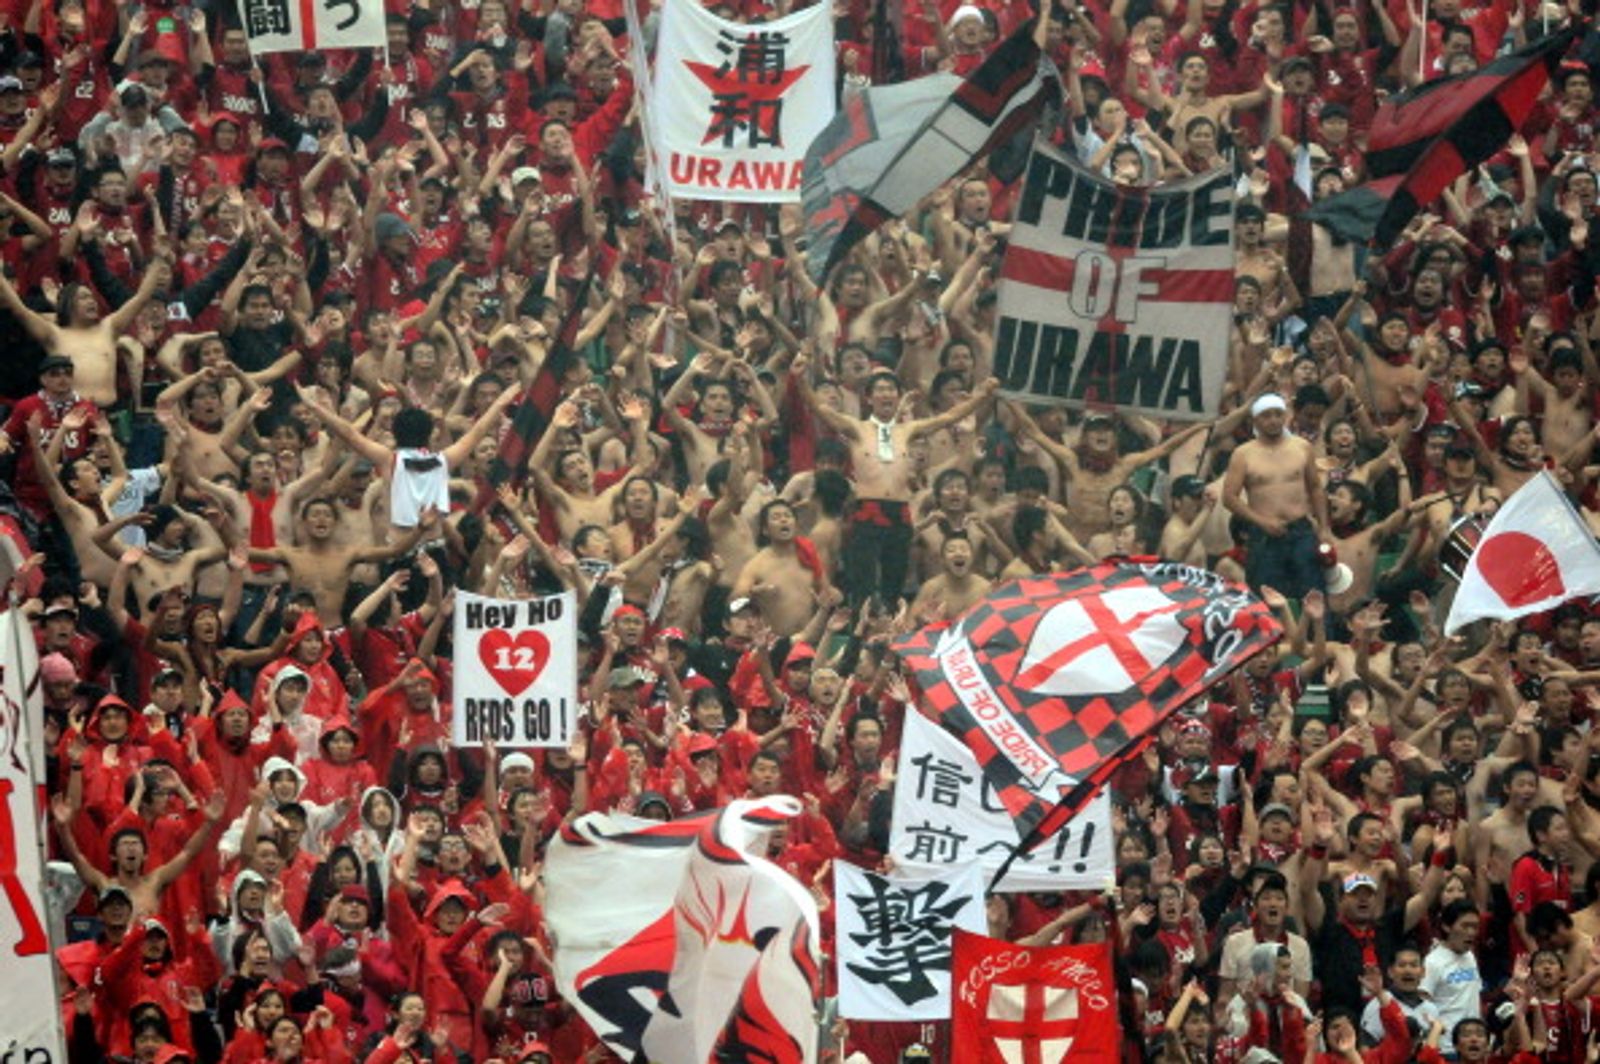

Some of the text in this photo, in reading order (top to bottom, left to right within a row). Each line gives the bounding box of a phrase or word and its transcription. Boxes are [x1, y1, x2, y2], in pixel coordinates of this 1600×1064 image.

[709, 29, 790, 148] 浦和
[1017, 150, 1232, 249] PRIDE
[1067, 250, 1166, 323] OF
[994, 315, 1204, 413] URAWA
[466, 602, 517, 629] Hey
[494, 646, 535, 670] 12
[523, 699, 550, 741] GO
[846, 872, 973, 1005] 撃
